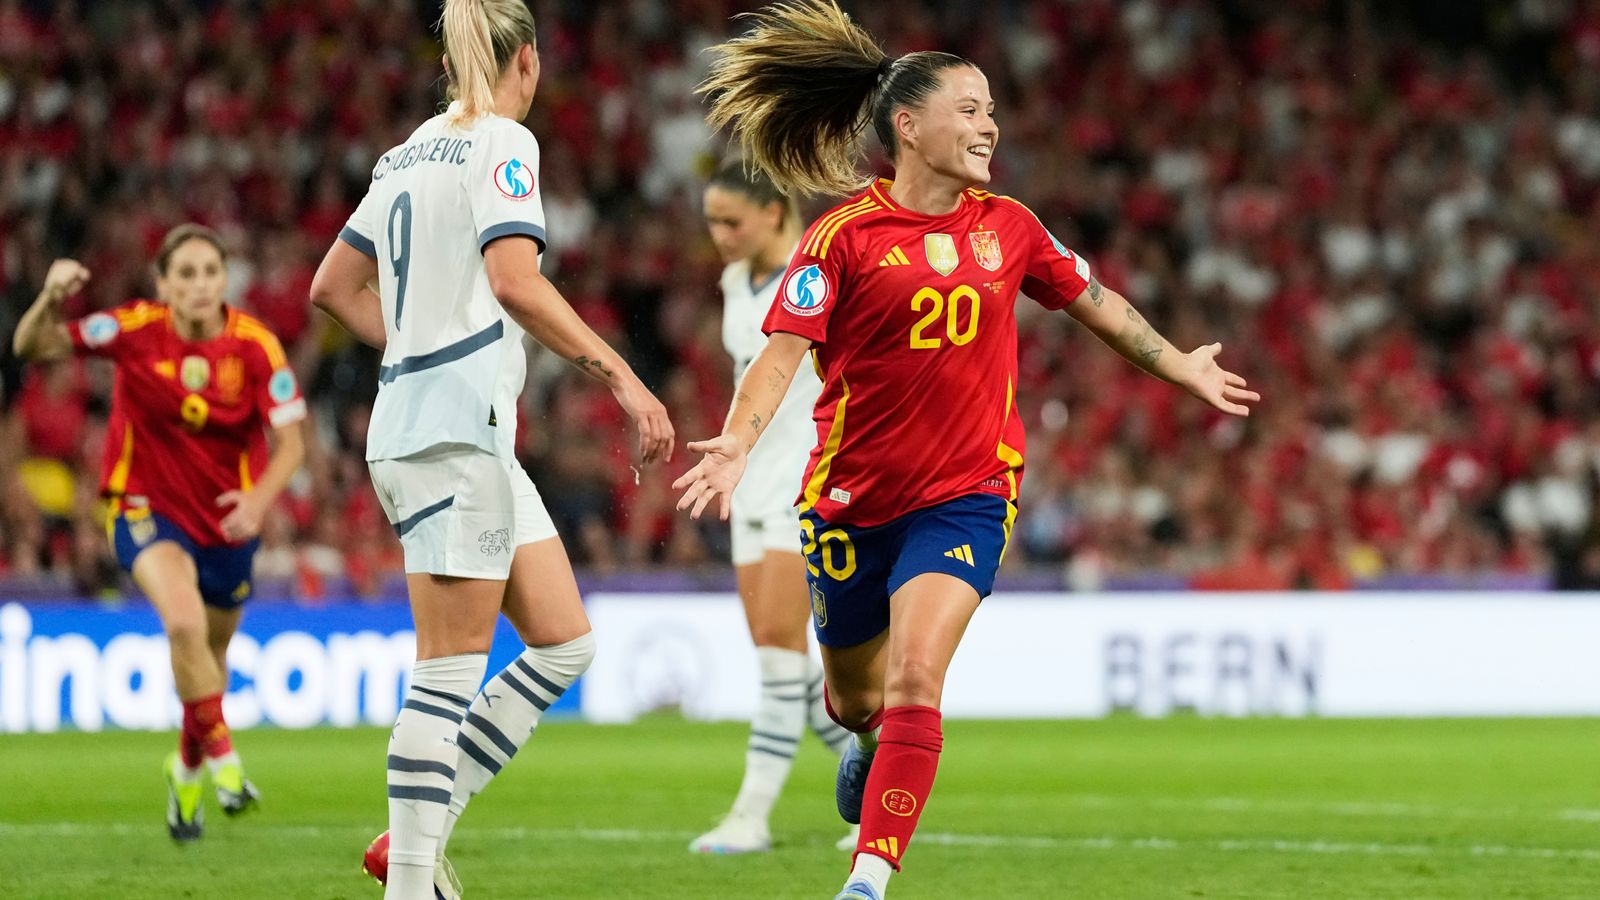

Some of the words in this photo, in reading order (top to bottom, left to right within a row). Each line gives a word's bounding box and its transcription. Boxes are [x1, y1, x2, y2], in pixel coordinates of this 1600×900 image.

[387, 190, 412, 332] 9
[910, 284, 981, 349] 20
[180, 393, 209, 432] 9
[800, 518, 857, 581] 20
[1104, 632, 1320, 710] BERN
